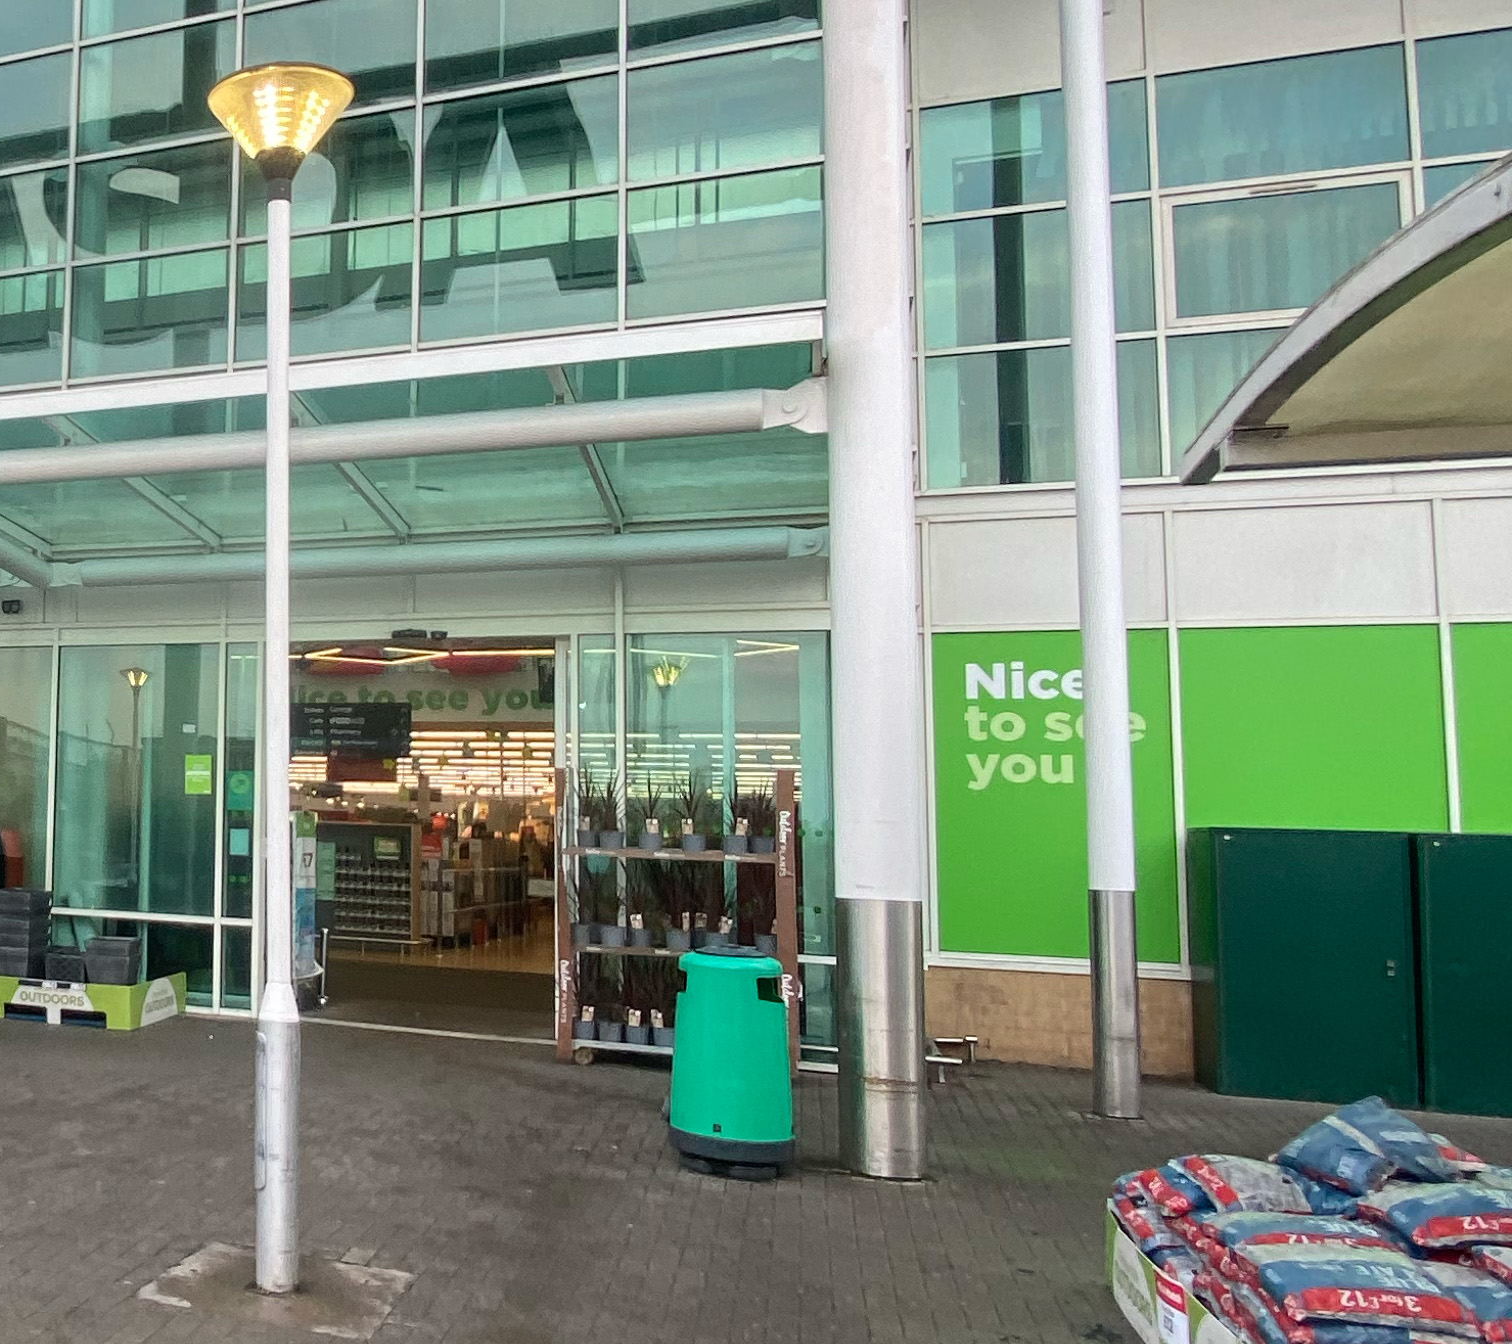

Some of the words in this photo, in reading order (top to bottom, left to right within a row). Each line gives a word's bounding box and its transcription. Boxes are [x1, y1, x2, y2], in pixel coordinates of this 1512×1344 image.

[964, 661, 1084, 700] Nice
[358, 686, 396, 705] to
[406, 688, 469, 711] see
[479, 687, 555, 716] you
[964, 705, 1026, 742] to
[965, 753, 1075, 791] you
[19, 989, 85, 1006] OUTDOORS
[1338, 1289, 1380, 1309] £12
[1404, 1295, 1423, 1313] 3
